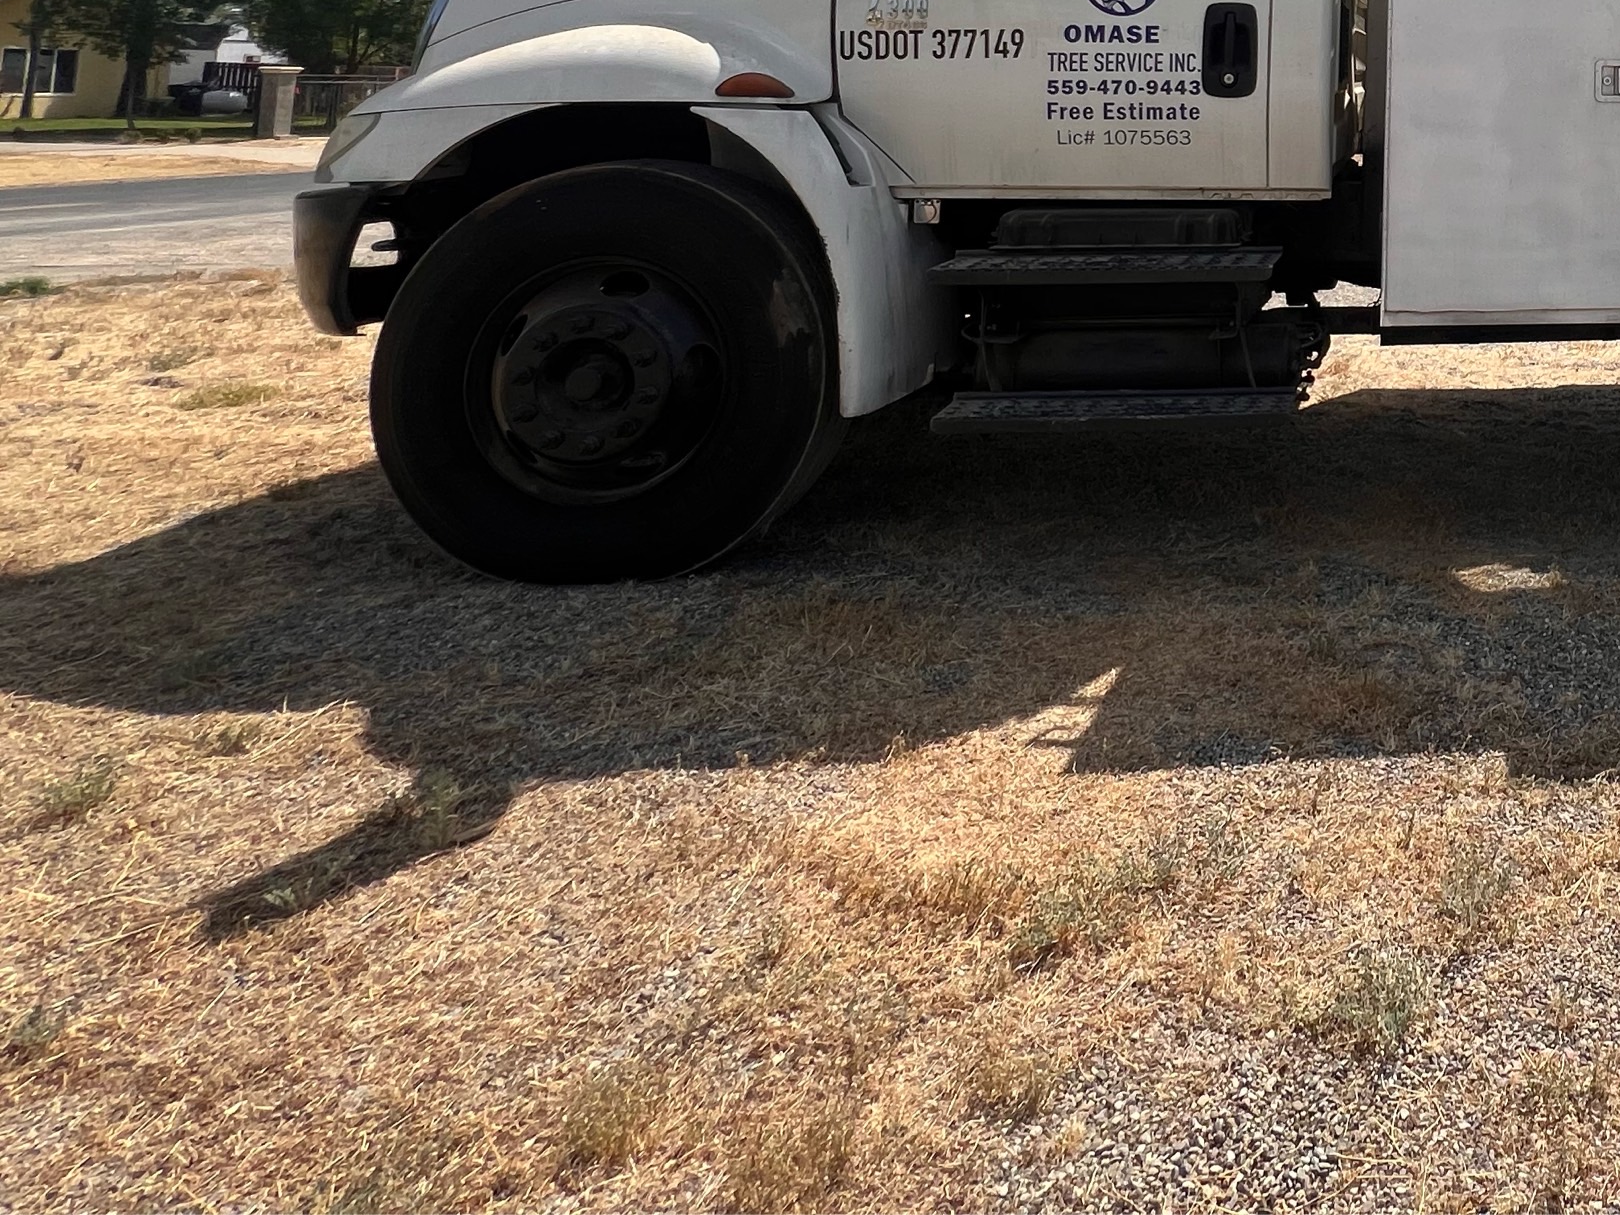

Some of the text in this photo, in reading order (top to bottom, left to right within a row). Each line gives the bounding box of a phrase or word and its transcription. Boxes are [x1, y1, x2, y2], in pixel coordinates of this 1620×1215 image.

[1063, 24, 1160, 44] OMASE
[840, 29, 1025, 60] USDOT 377149
[1047, 52, 1201, 73] TREE SERVICE INC.
[1047, 80, 1201, 95] 559-470-9443
[1047, 102, 1200, 120] Free Estimate
[1057, 130, 1192, 145] Lic# 1075563
